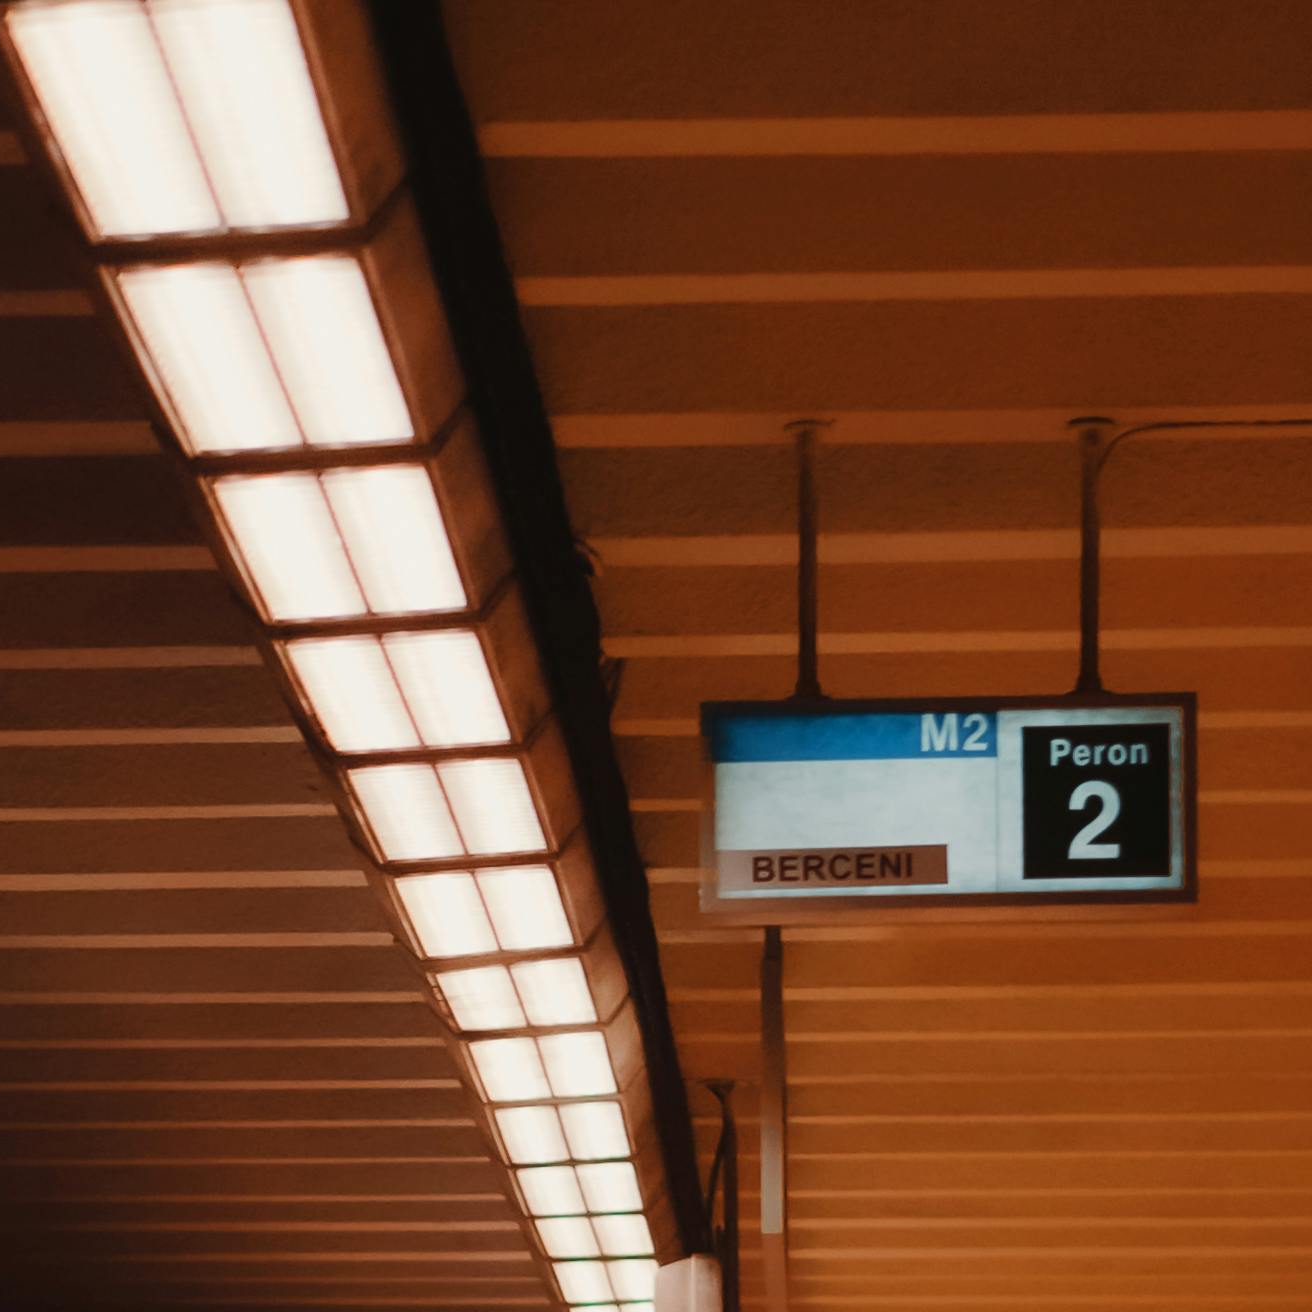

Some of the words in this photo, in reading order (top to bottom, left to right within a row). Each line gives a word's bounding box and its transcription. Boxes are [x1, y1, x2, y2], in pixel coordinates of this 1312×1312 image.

[920, 714, 989, 752] M2
[1050, 738, 1150, 767] Peron
[1068, 780, 1121, 860] 2
[751, 853, 915, 884] BERCENI
